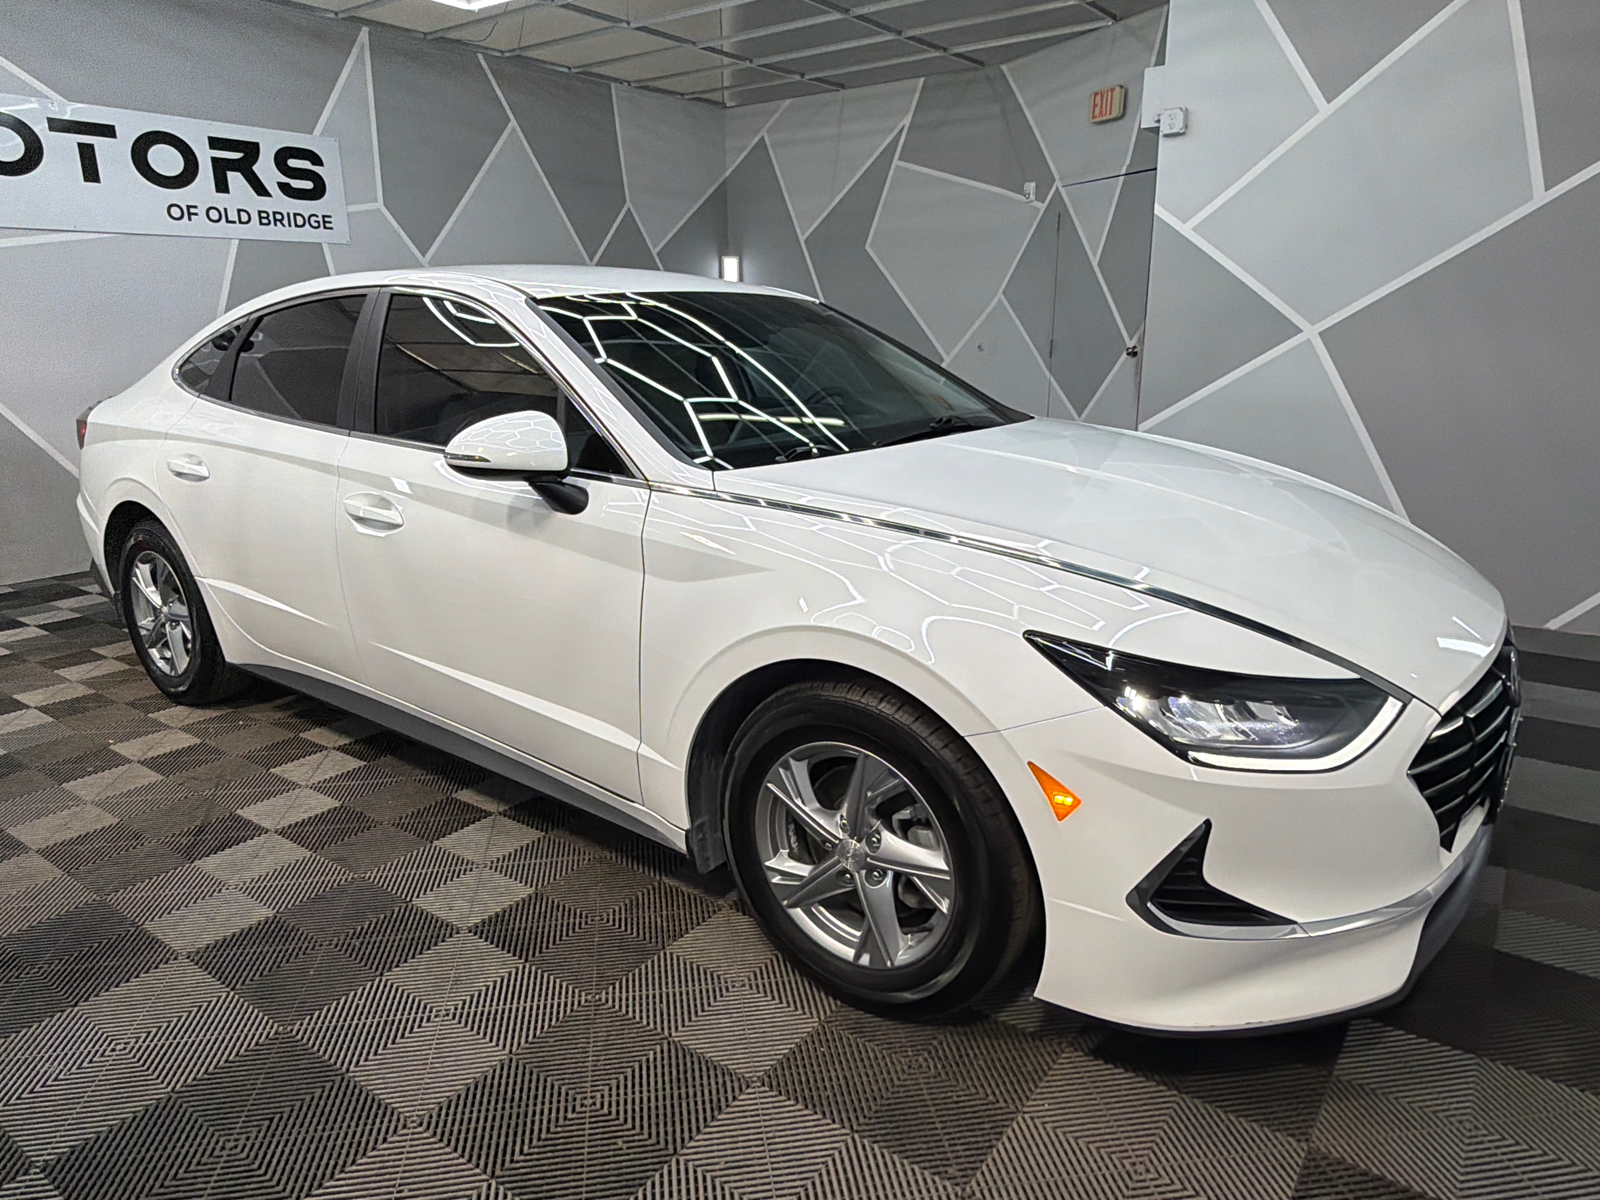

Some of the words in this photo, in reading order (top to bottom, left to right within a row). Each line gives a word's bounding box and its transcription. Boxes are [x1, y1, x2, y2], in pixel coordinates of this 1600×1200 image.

[1091, 87, 1116, 120] EXIT
[166, 203, 199, 222] OF
[205, 206, 252, 225] OLD
[257, 209, 334, 231] BRIDGE
